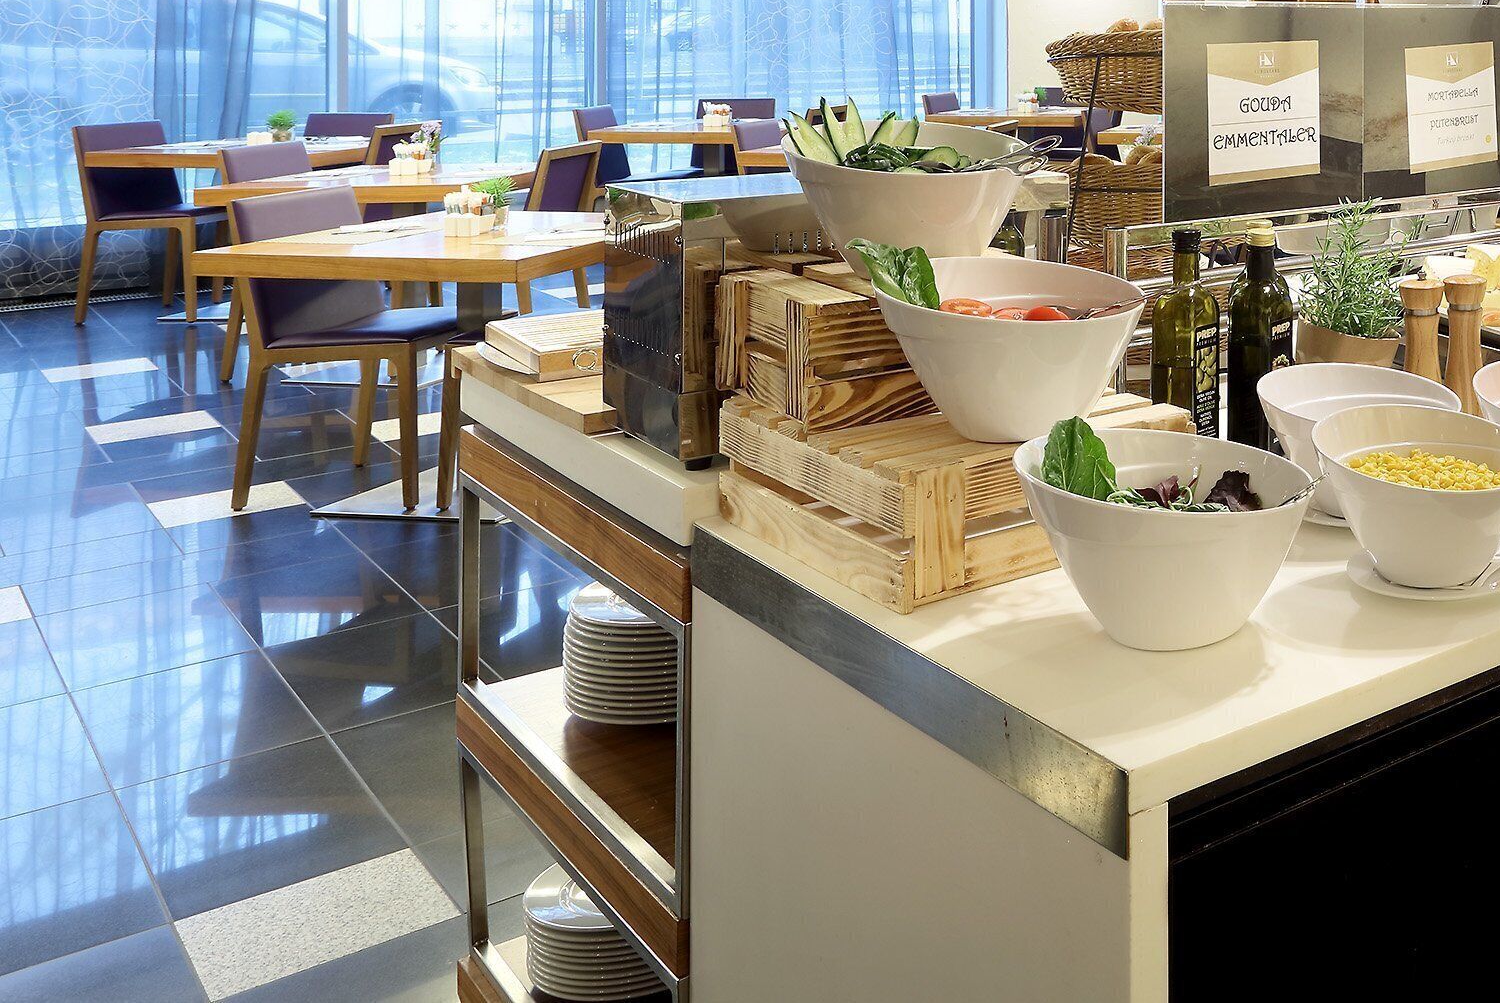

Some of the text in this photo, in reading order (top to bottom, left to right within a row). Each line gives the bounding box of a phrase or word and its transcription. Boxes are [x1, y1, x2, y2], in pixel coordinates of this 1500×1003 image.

[1427, 87, 1479, 102] MORTADELLA
[1239, 95, 1292, 114] GOUDA
[1429, 113, 1479, 131] PUTENBRUST
[1213, 126, 1318, 150] EMMENTALER
[1196, 326, 1217, 342] PREP
[1271, 321, 1290, 337] PREP
